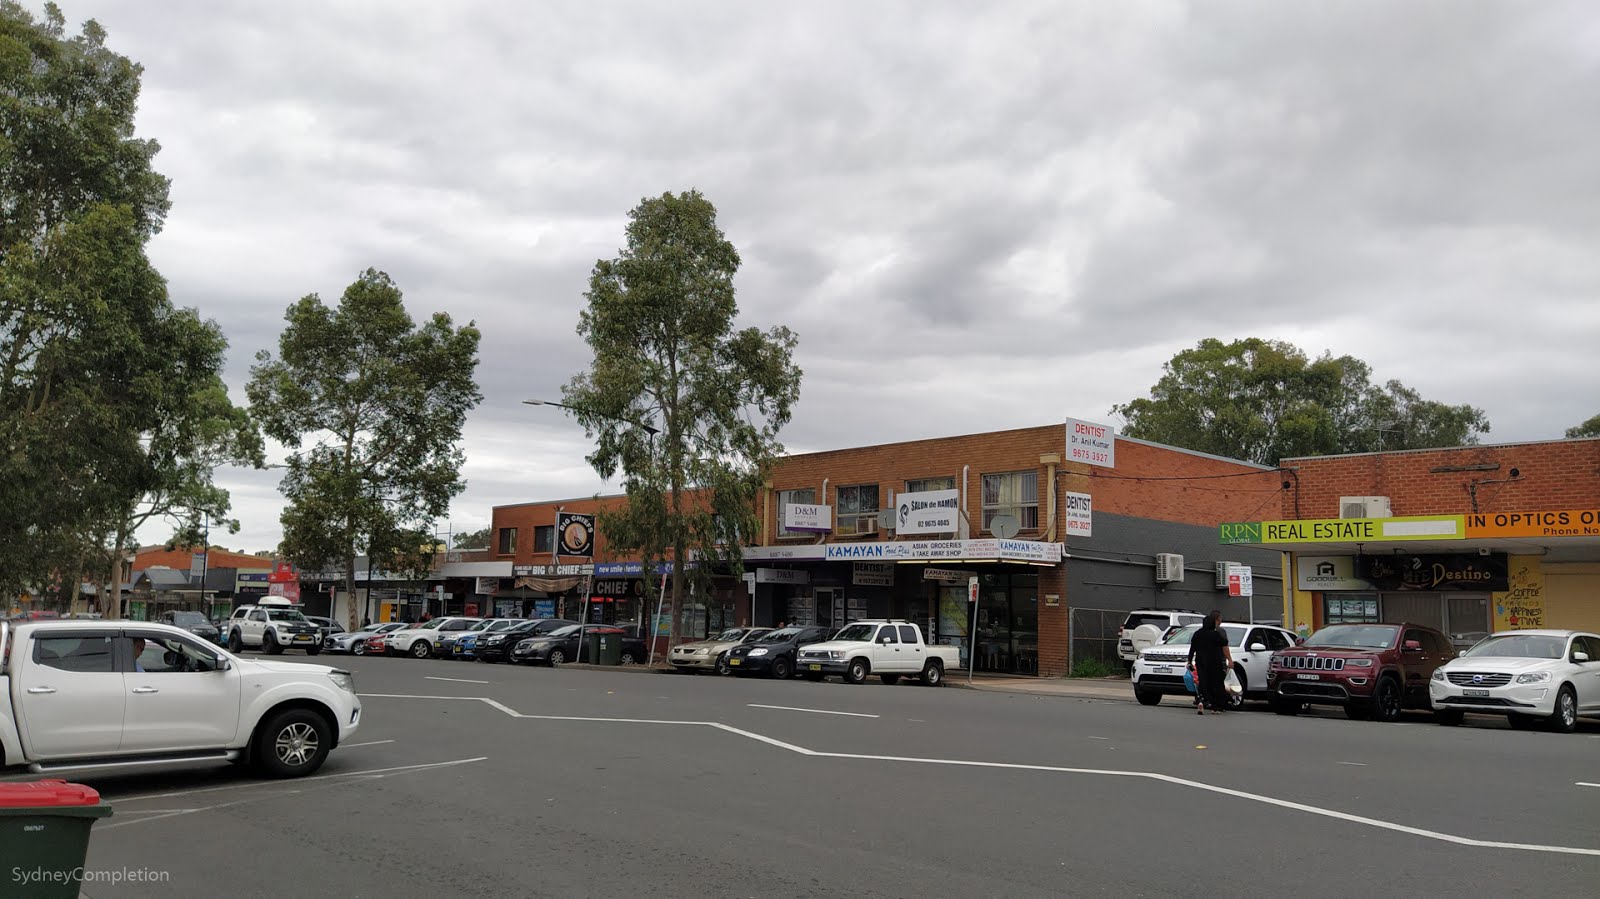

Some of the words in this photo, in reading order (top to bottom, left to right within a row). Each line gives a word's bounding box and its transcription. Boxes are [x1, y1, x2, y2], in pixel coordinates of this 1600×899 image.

[1075, 423, 1106, 438] DENTIST
[1071, 435, 1080, 444] Dr.
[1092, 439, 1110, 449] Kumar
[1072, 448, 1090, 459] 9675
[1091, 452, 1108, 462] 3927
[911, 501, 928, 511] SALON
[937, 498, 958, 508] RAMON
[1066, 495, 1091, 511] DENTIST
[794, 506, 818, 516] D&M
[559, 518, 571, 532] BIG
[1494, 511, 1570, 527] OPTICS
[1220, 523, 1260, 539] RPN
[1268, 524, 1308, 540] REAL
[1313, 522, 1374, 538] ESTATE
[1543, 526, 1579, 536] Phone
[828, 545, 883, 558] KAMAYAN
[1000, 541, 1030, 552] KAMAYAN
[532, 565, 546, 575] BIG
[556, 564, 580, 575] CHIEF
[610, 564, 623, 573] smile
[855, 563, 885, 572] DENTIST
[1431, 562, 1491, 588] Destino
[597, 581, 629, 595] CHIEF
[1513, 588, 1540, 597] COFFEE
